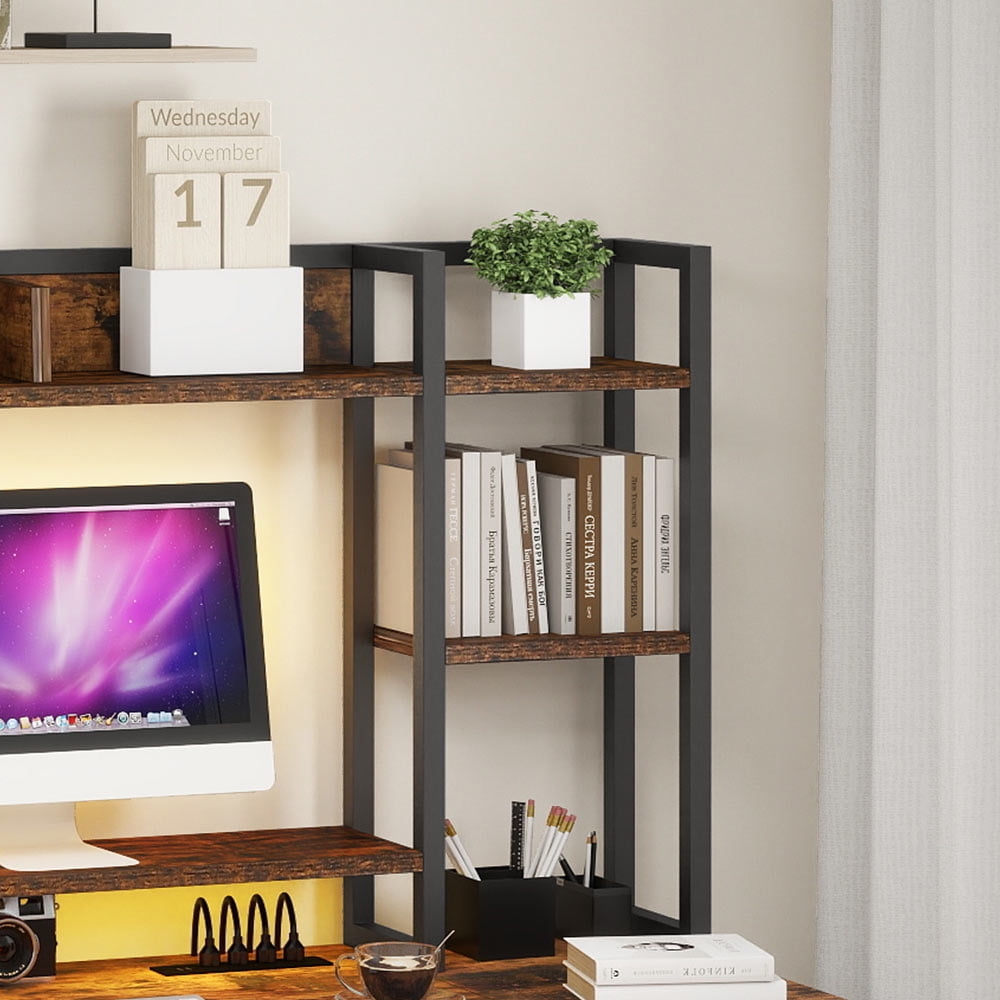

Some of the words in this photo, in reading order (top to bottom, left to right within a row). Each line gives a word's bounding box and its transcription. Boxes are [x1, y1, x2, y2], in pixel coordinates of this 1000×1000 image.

[150, 106, 261, 130] Wednesday
[166, 142, 263, 162] November
[486, 530, 498, 563] Братья
[584, 515, 596, 559] СЕСТРА
[486, 566, 498, 624] Карамазовы
[584, 562, 596, 598] КЕРРИ
